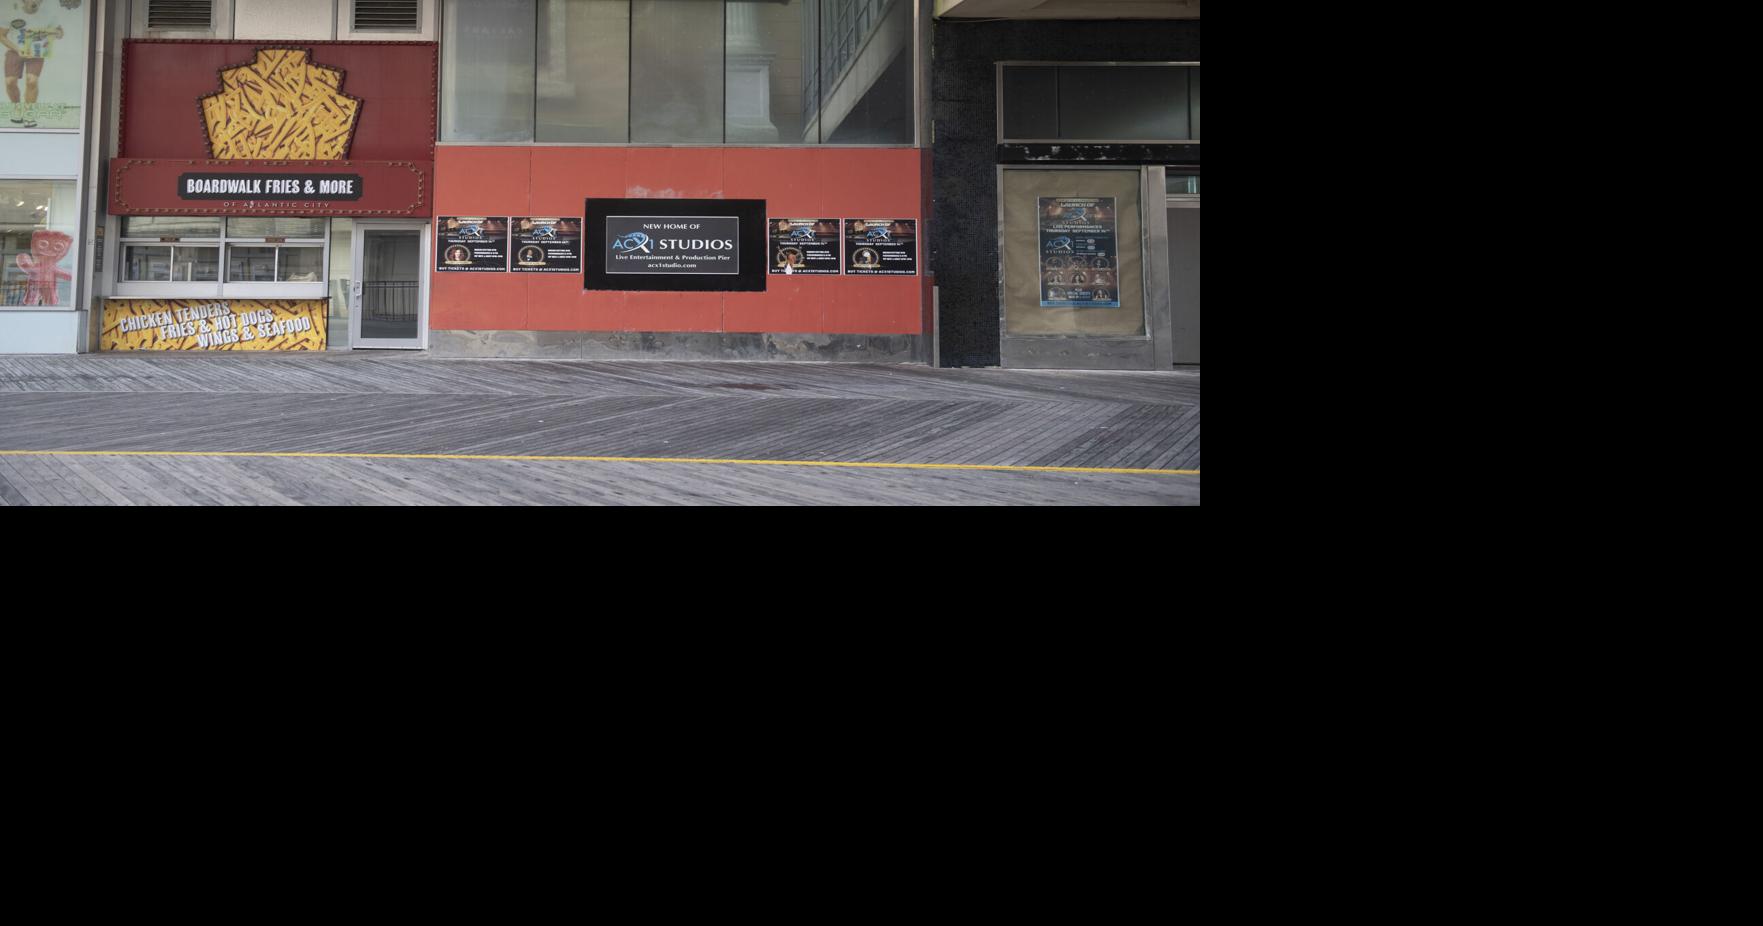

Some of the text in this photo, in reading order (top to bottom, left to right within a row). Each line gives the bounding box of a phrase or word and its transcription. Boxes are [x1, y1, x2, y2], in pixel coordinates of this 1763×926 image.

[187, 179, 353, 194] BOARDWALK FRIES & MORE
[660, 239, 733, 250] STUDIOS
[120, 302, 230, 333] CHICKEN TENDERS
[161, 308, 274, 340] FRIES & HOT DOGS
[197, 316, 311, 347] WINGS & SEAFOOD
